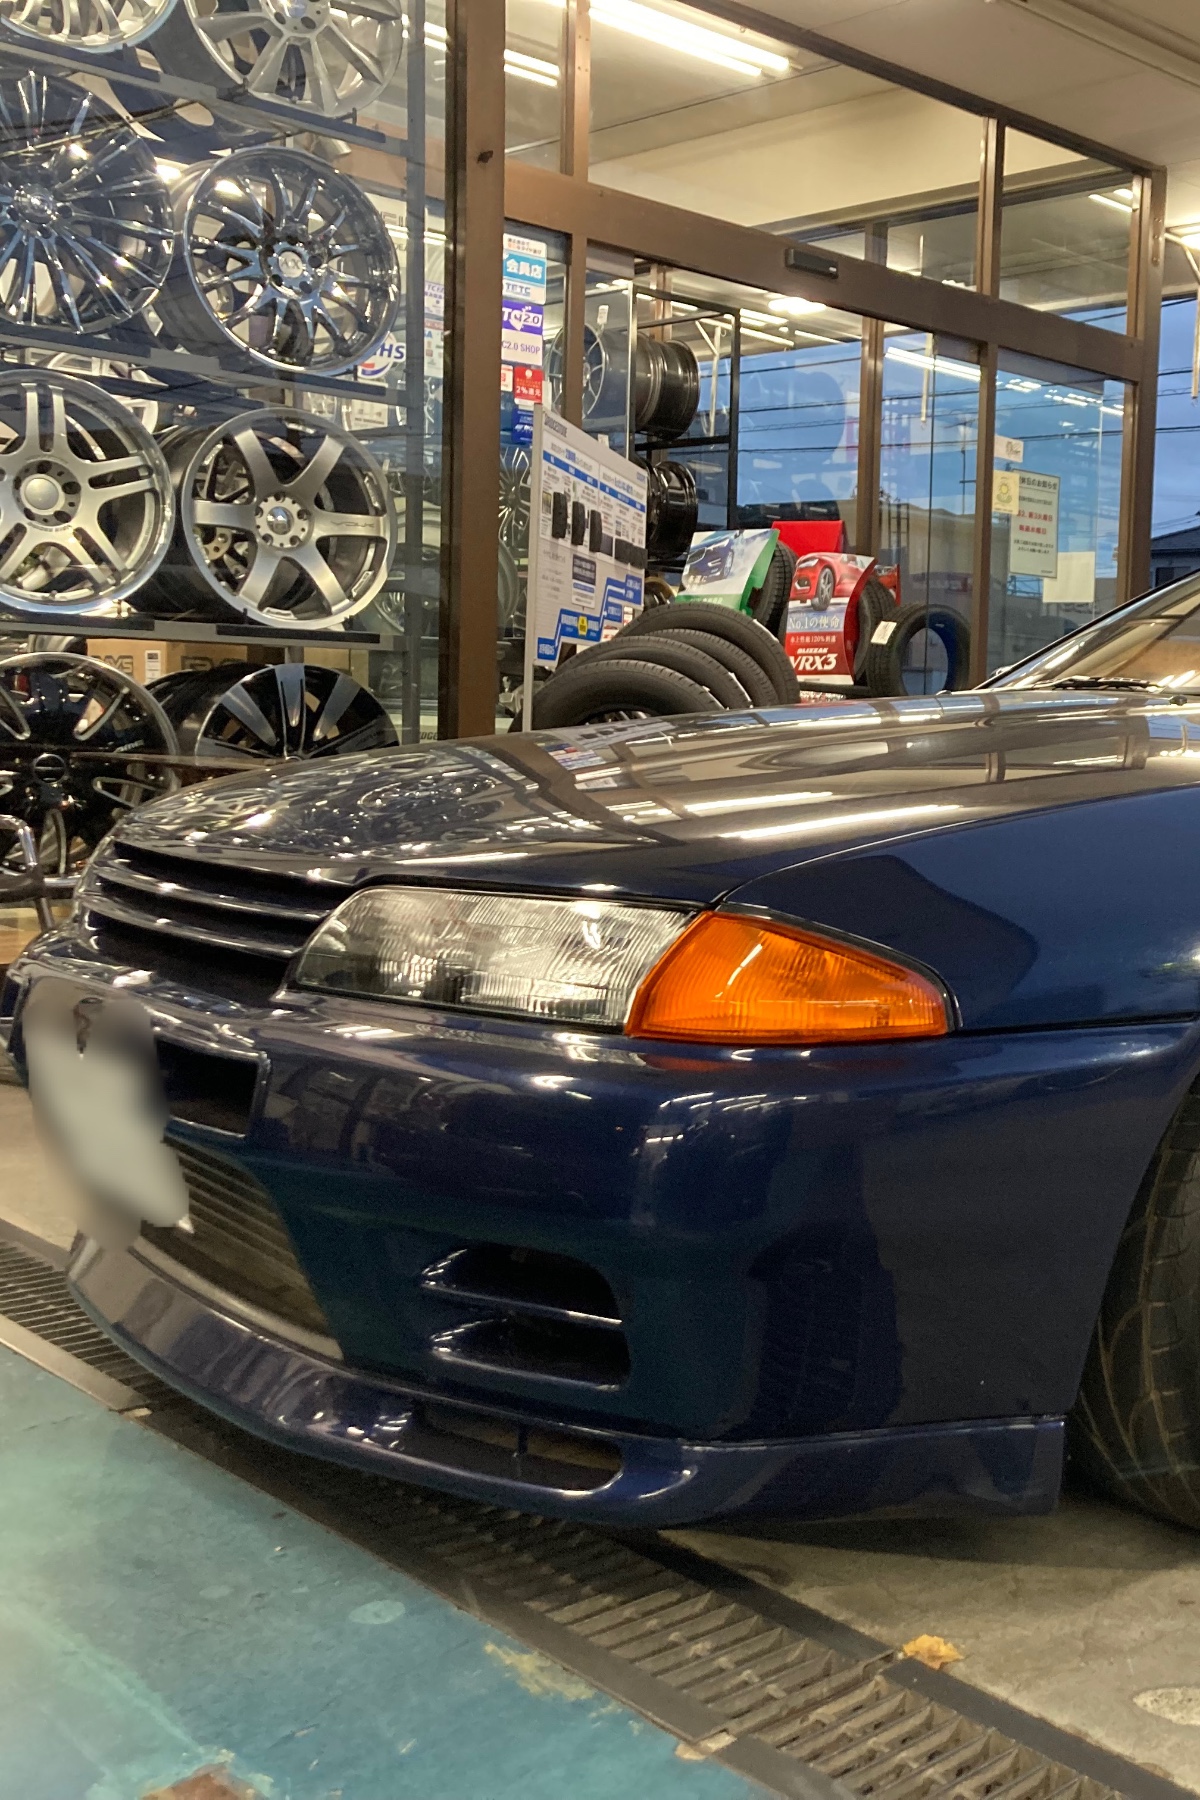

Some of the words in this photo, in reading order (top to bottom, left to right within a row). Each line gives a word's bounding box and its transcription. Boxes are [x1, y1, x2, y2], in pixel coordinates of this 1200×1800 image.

[506, 259, 543, 280] 会員店
[520, 344, 541, 354] SHOP
[1019, 476, 1057, 490] 休日のお知らせ
[789, 615, 840, 630] No.1の使命
[789, 653, 838, 671] VRX3
